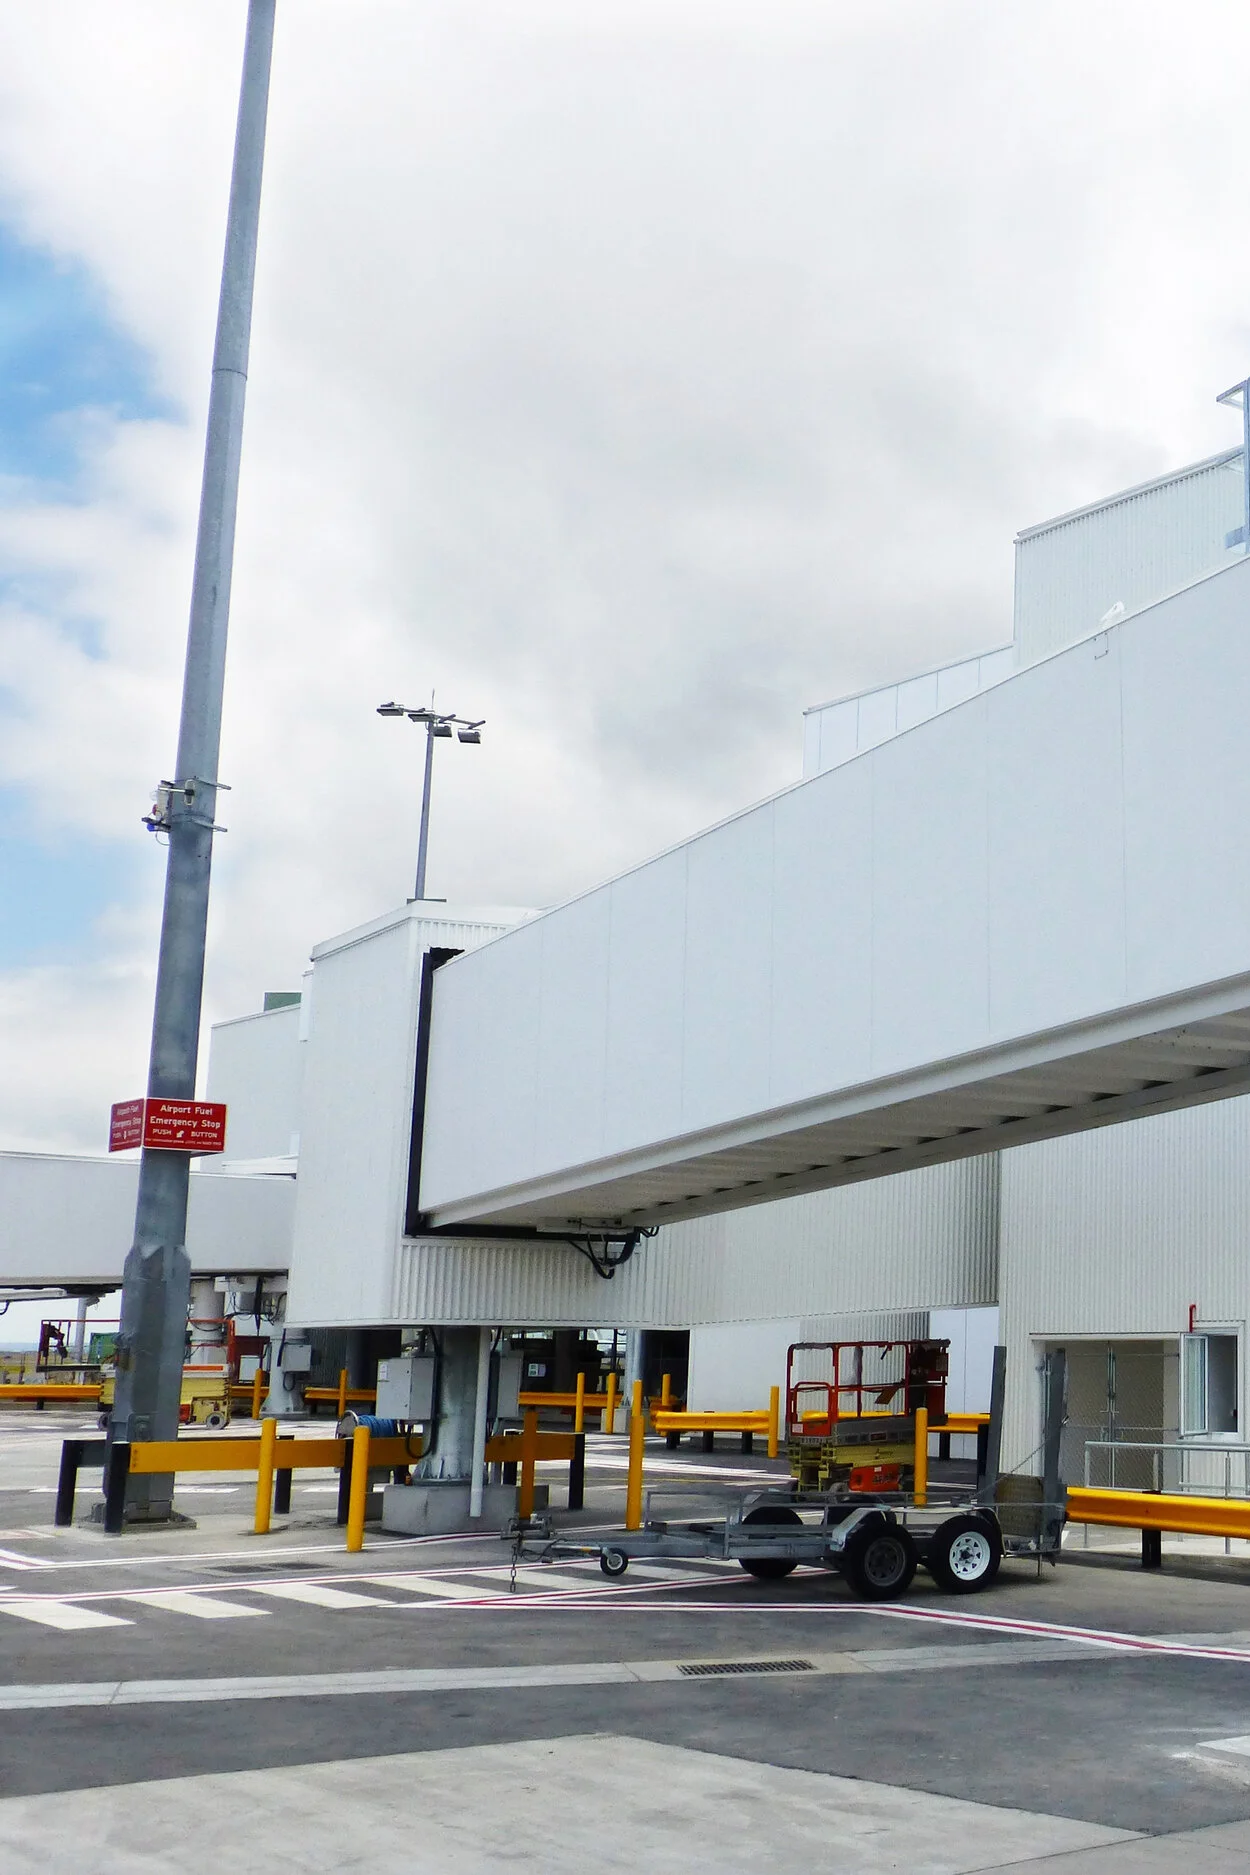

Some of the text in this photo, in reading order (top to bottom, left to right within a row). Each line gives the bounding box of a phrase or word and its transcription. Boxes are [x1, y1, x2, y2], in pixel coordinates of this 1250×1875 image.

[160, 1104, 213, 1115] Airport Fuel
[150, 1116, 221, 1130] Emergency Stop
[152, 1128, 172, 1136] PUSH
